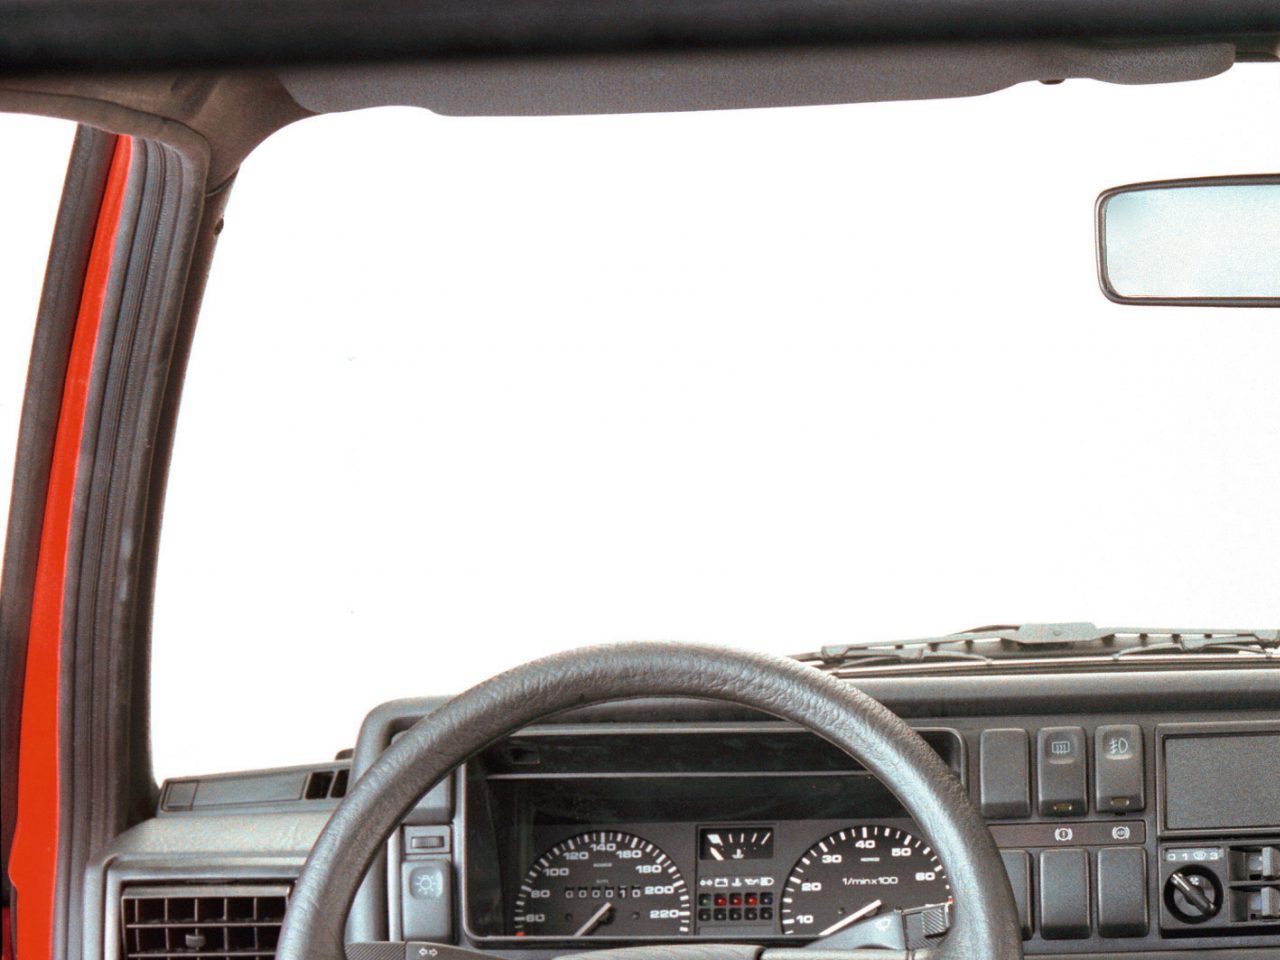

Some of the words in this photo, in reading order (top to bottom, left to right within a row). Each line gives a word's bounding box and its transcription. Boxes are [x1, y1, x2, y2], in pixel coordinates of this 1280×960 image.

[590, 843, 617, 852] 140
[855, 840, 875, 848] 40
[563, 851, 589, 860] 120
[891, 848, 911, 856] 50
[822, 855, 842, 864] 30
[543, 867, 569, 876] 100
[644, 886, 674, 895] 200
[801, 882, 821, 891] 20
[531, 889, 550, 898] 80
[650, 910, 679, 919] 220
[796, 915, 813, 924] 10
